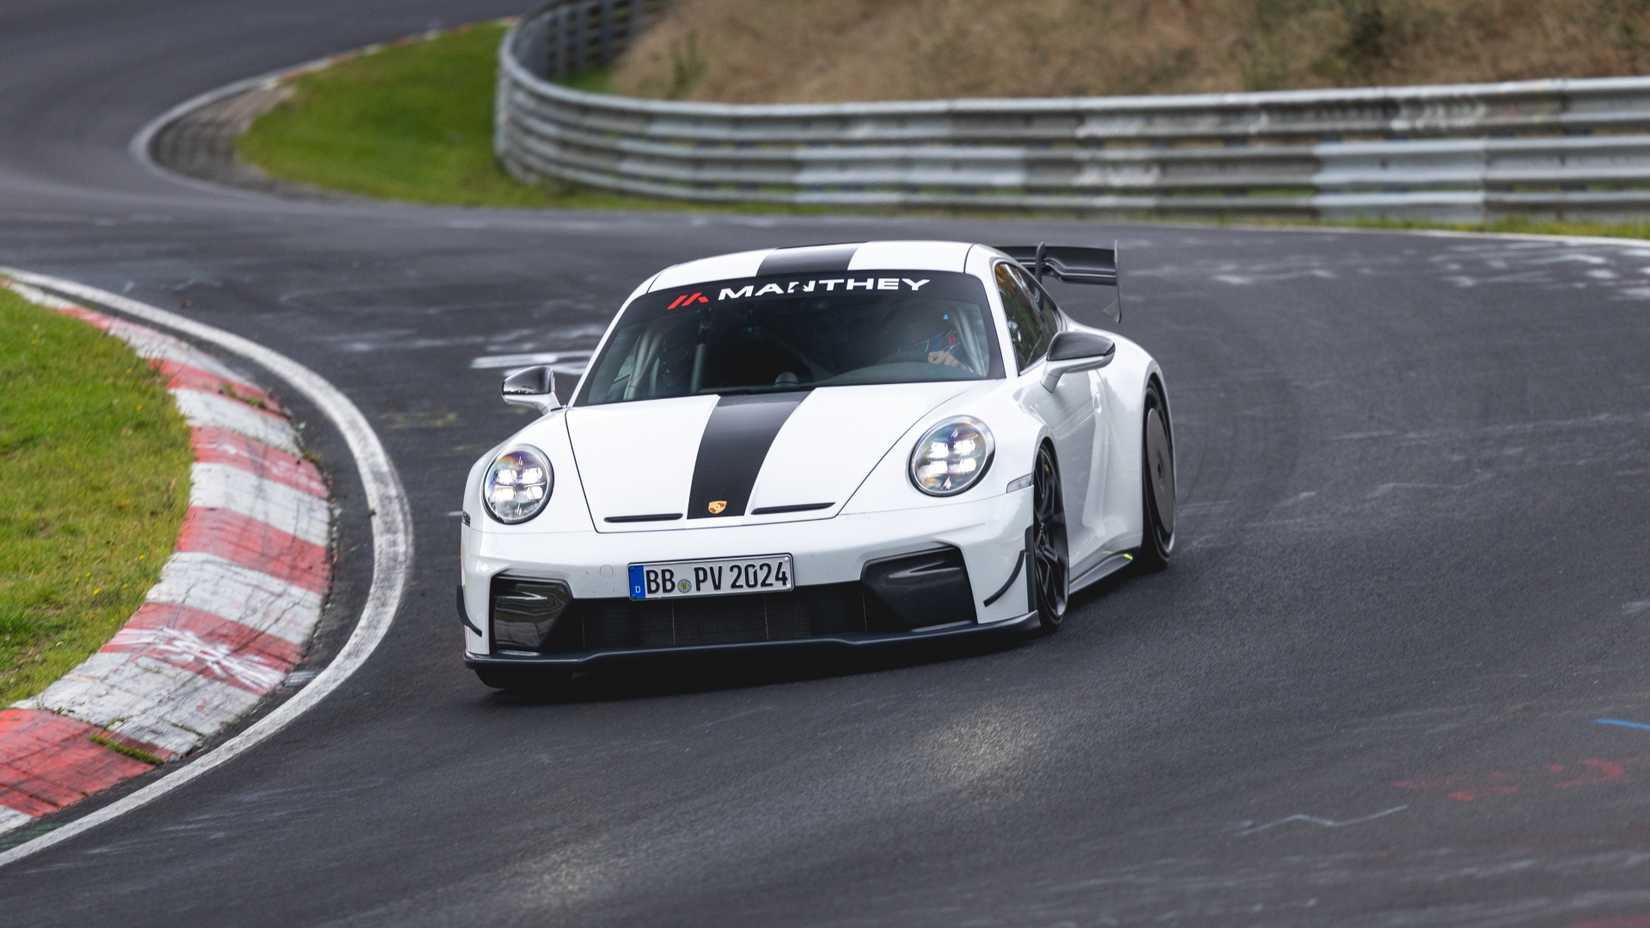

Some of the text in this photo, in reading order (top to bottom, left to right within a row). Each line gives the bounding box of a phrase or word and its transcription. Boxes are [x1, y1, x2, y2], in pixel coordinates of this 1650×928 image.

[718, 278, 930, 300] MANTHEY
[645, 562, 789, 594] BB PV 2024
